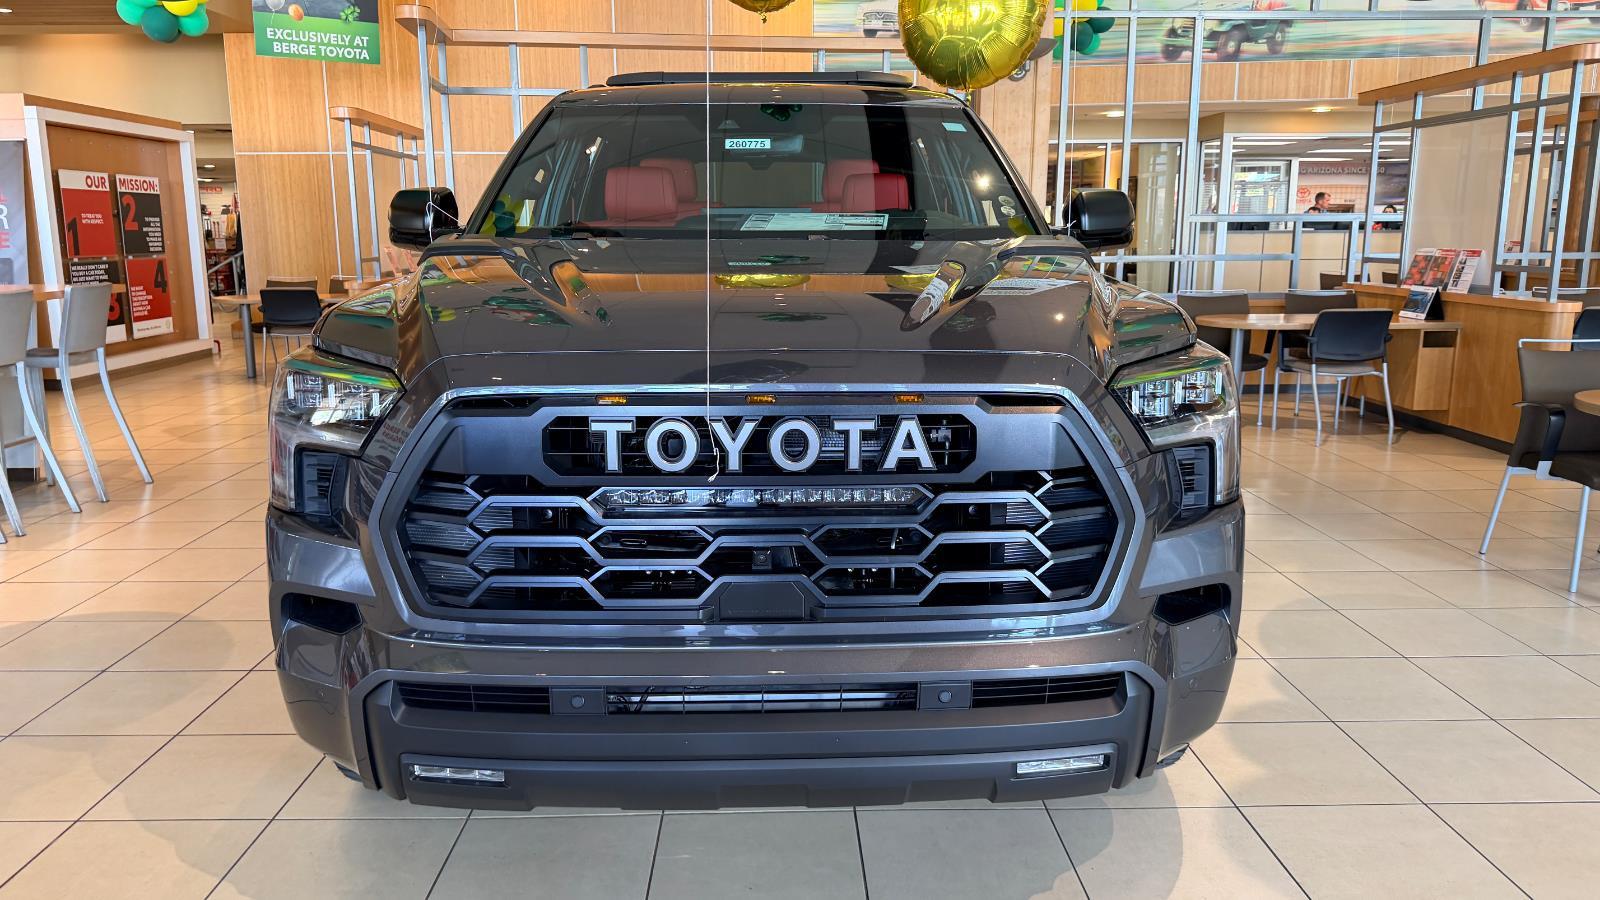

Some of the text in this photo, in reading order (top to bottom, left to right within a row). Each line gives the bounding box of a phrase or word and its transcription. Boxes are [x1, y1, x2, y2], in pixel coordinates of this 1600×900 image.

[266, 28, 369, 47] EXCLUSIVELY AT
[273, 42, 370, 60] BERGE TOYOTA
[728, 140, 766, 148] 260775
[85, 175, 158, 192] OUR MISSION:
[121, 194, 139, 231] 2
[67, 217, 80, 256] 1
[154, 260, 168, 294] 4
[588, 416, 937, 473] TOYOTA
